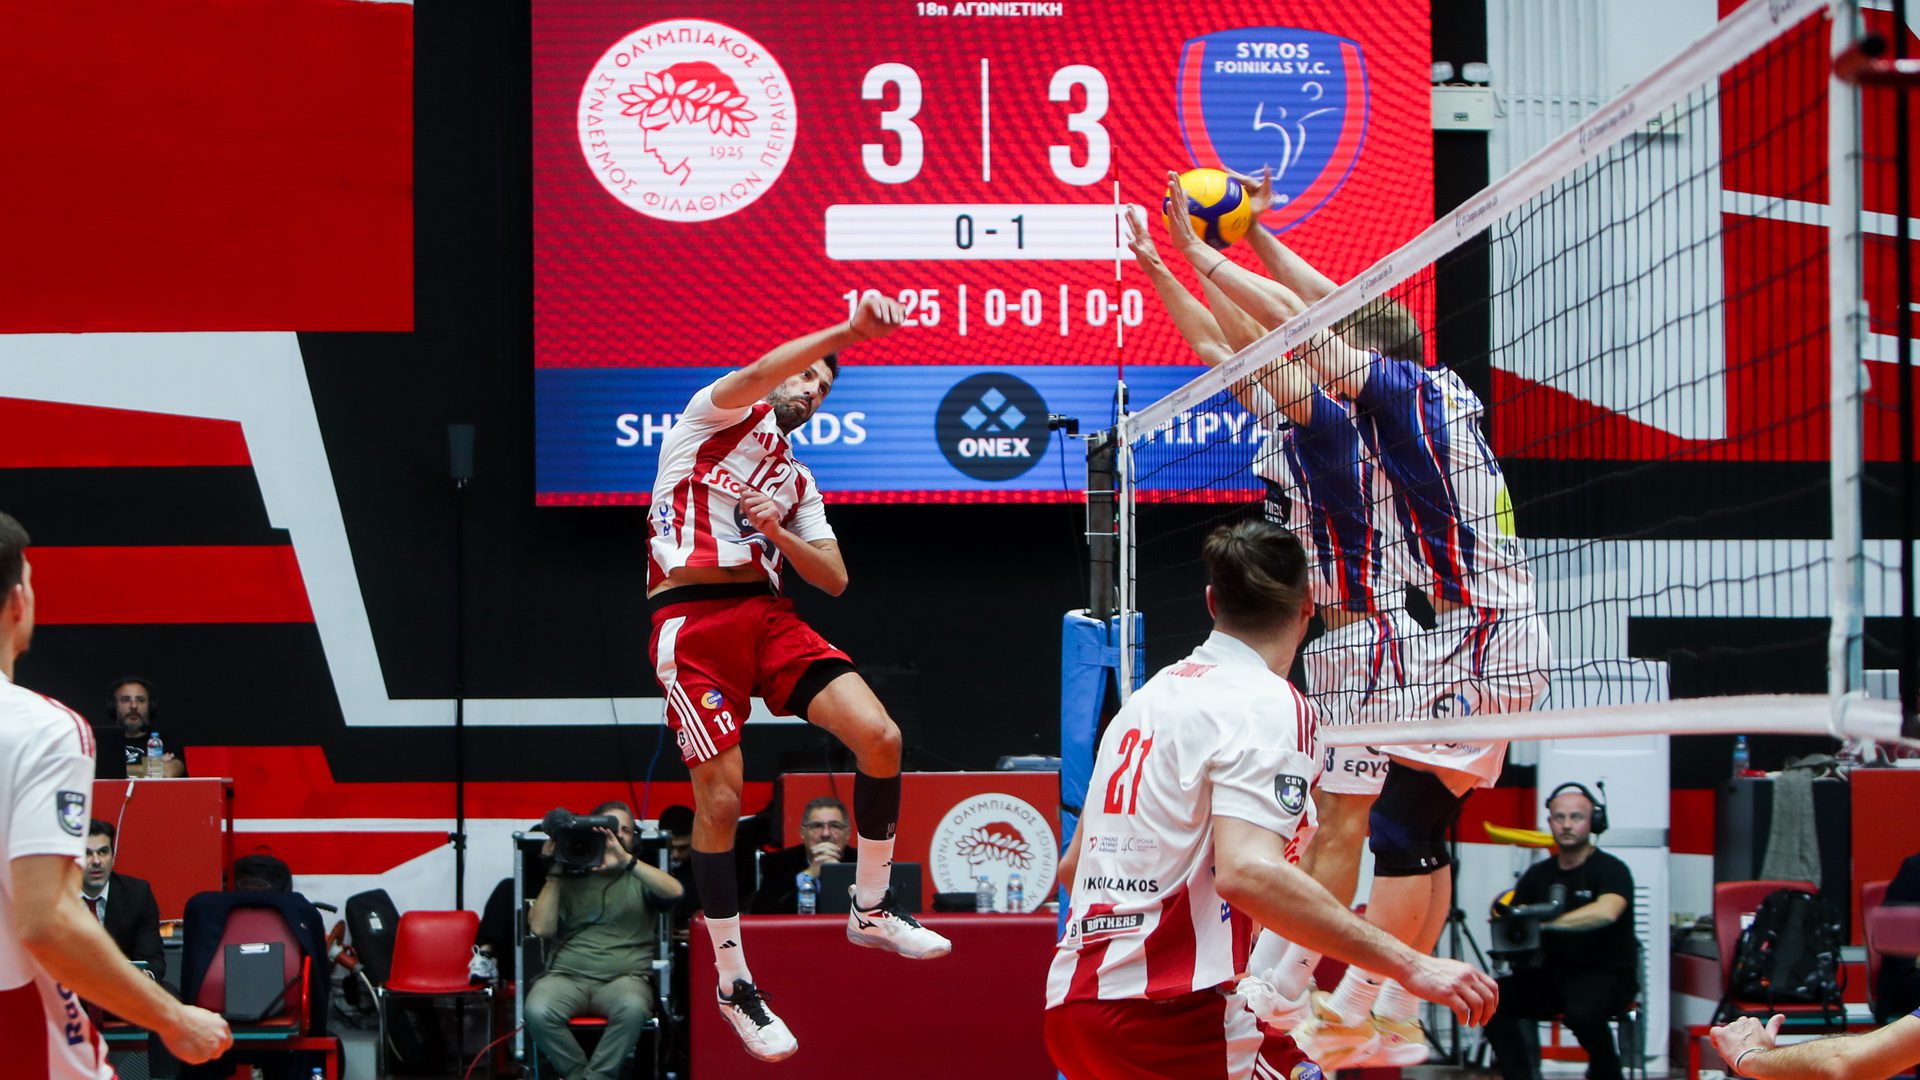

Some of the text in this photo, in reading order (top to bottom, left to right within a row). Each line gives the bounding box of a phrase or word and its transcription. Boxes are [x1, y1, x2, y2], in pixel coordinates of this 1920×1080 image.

[952, 2, 1063, 16] ΑΓΩΝΙΣΤΙΚΗ
[614, 27, 760, 68] ΟΛΥΜΠΙΑΚΟΣ
[1214, 60, 1331, 75] FOINIKAS V.C.
[1236, 42, 1310, 59] SYROS
[587, 72, 638, 195] ΣΥΝΔΕΣΜΟΣ
[758, 70, 787, 168] ΠΕΙΡΑΙΩΣ
[861, 62, 924, 184] 3
[1048, 64, 1111, 186] 3
[709, 146, 744, 160] 1925
[643, 171, 762, 212] ΦΙΛΑΘΛΩΝ
[958, 438, 1031, 458] ONEX
[751, 456, 791, 499] 12
[714, 711, 736, 734] 12
[1103, 728, 1155, 815] 21
[953, 799, 1037, 826] ΟΛΥΜΠΙΑΚΟΣ
